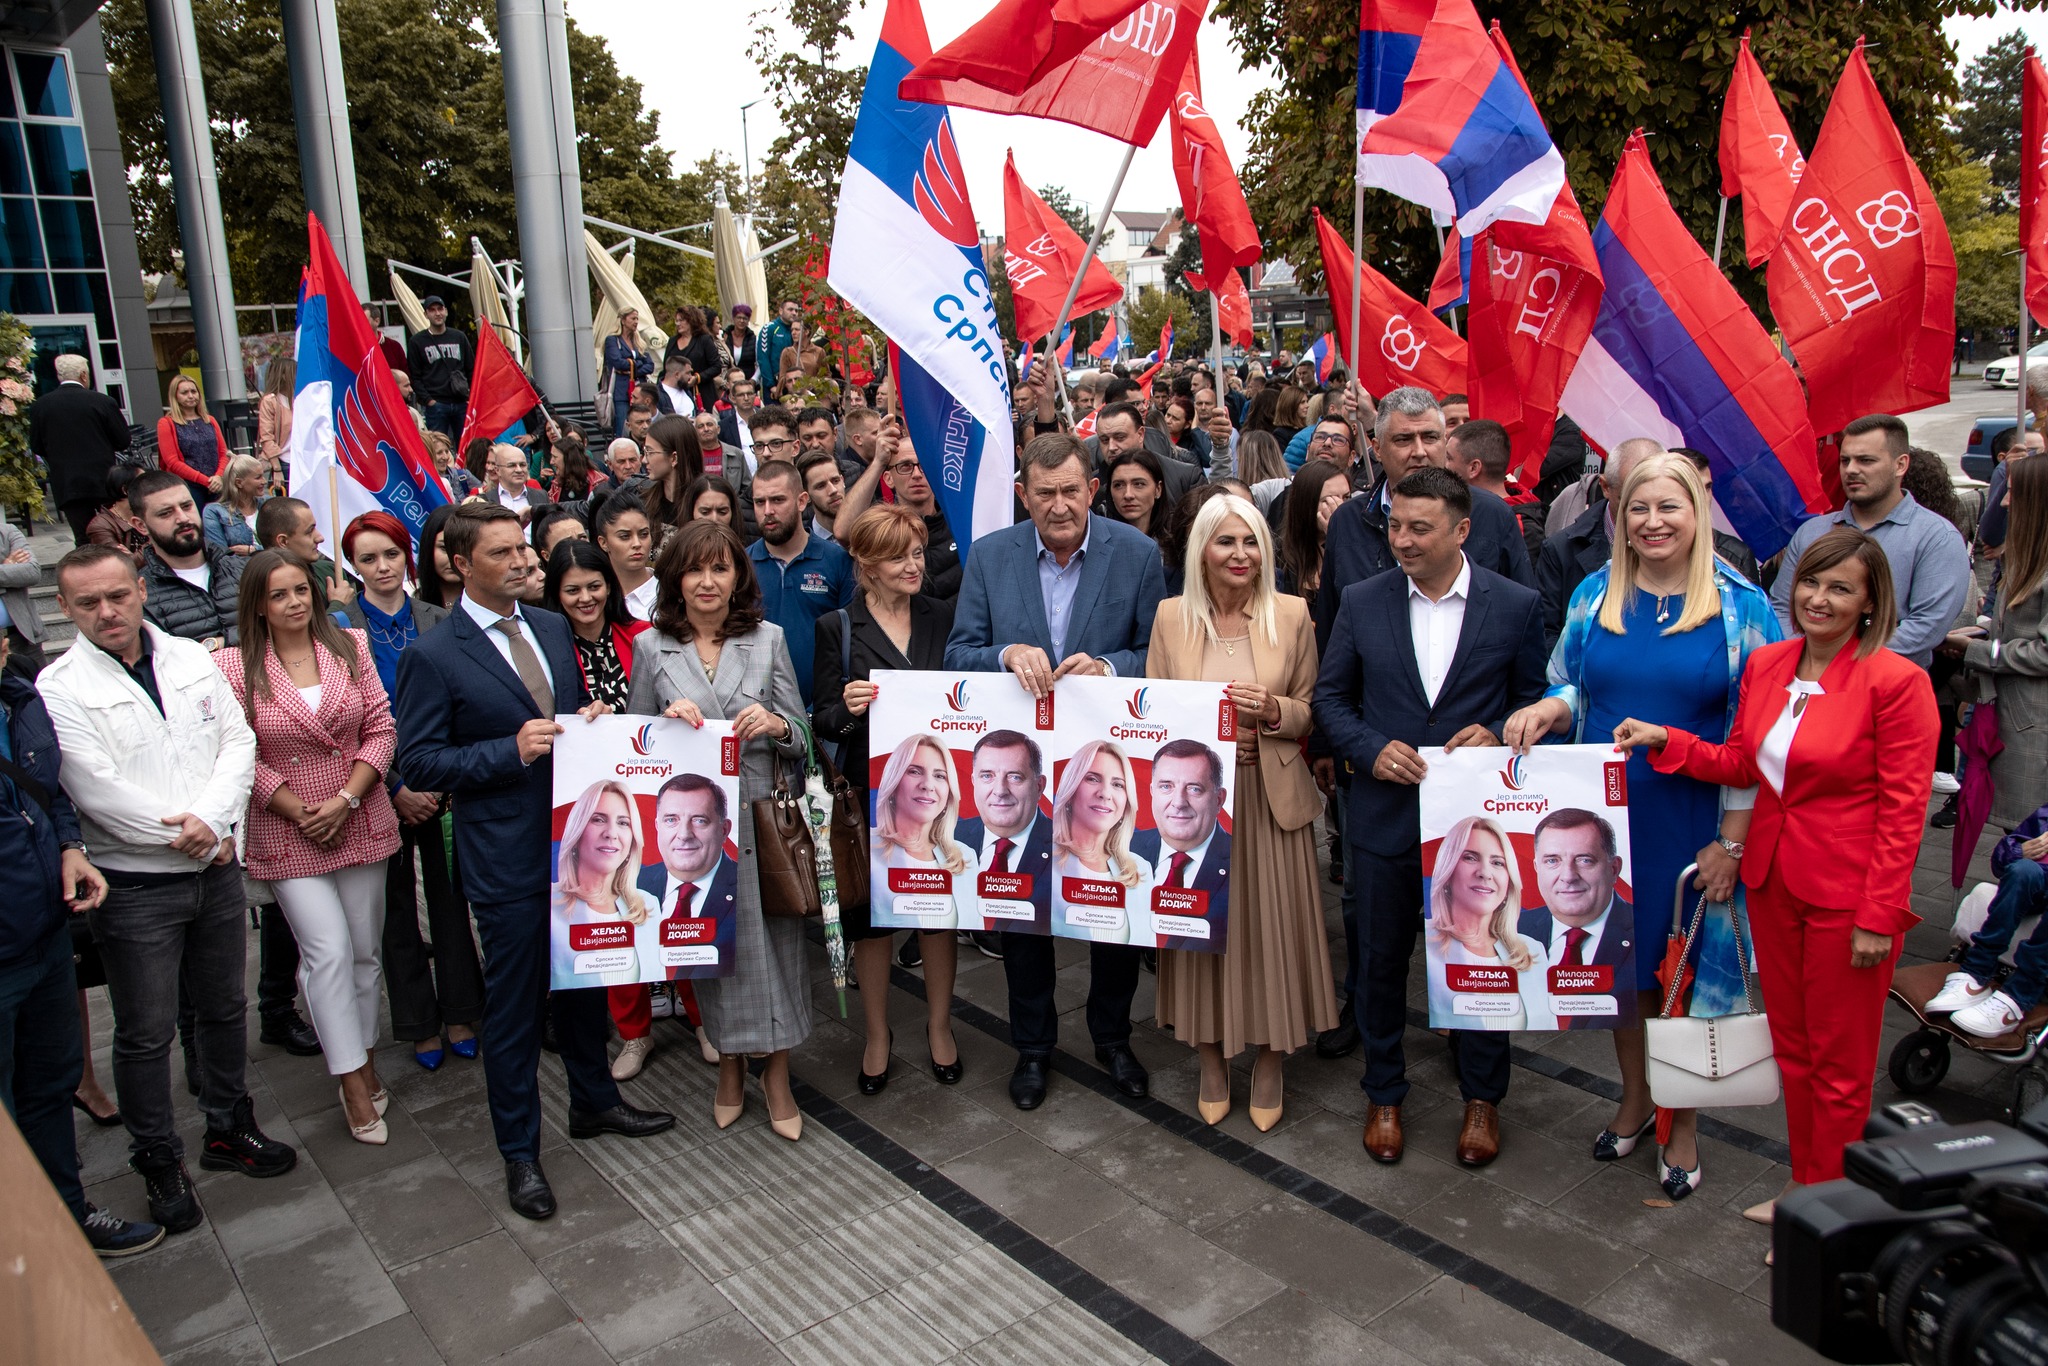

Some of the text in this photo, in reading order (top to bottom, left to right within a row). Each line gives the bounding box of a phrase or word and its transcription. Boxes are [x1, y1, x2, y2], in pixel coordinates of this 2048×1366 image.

[1792, 197, 1882, 322] СНСД
[933, 294, 1012, 418] Српск
[941, 714, 953, 722] Јер
[1222, 705, 1230, 727] СНСД
[931, 719, 987, 732] Српску!
[1121, 721, 1133, 729] Јер
[1110, 726, 1168, 741] Српску!
[616, 764, 672, 777] Српску!
[1608, 767, 1616, 791] СНСД
[1496, 793, 1510, 801] Јер
[1484, 799, 1549, 814] Српску!
[909, 873, 944, 882] ЖЕЉКА
[985, 876, 1022, 885] Милорад
[898, 881, 944, 890] Цвијановић
[985, 884, 1017, 892] ДОДИК
[1082, 883, 1117, 893] ЖЕЉКА
[1071, 891, 1118, 902] Цвијановић
[1160, 890, 1197, 901] Милорад
[1159, 900, 1192, 909] ДОДИК
[591, 927, 626, 935] ЖЕЉКА
[668, 923, 705, 931] Милорад
[668, 930, 700, 939] ДОДИК
[579, 936, 628, 946] Цвијановић
[1468, 970, 1508, 979] ЖЕЉКА
[1557, 970, 1599, 979] Милорад
[1457, 978, 1510, 989] Цвијановић
[1557, 978, 1594, 987] ДОДИК
